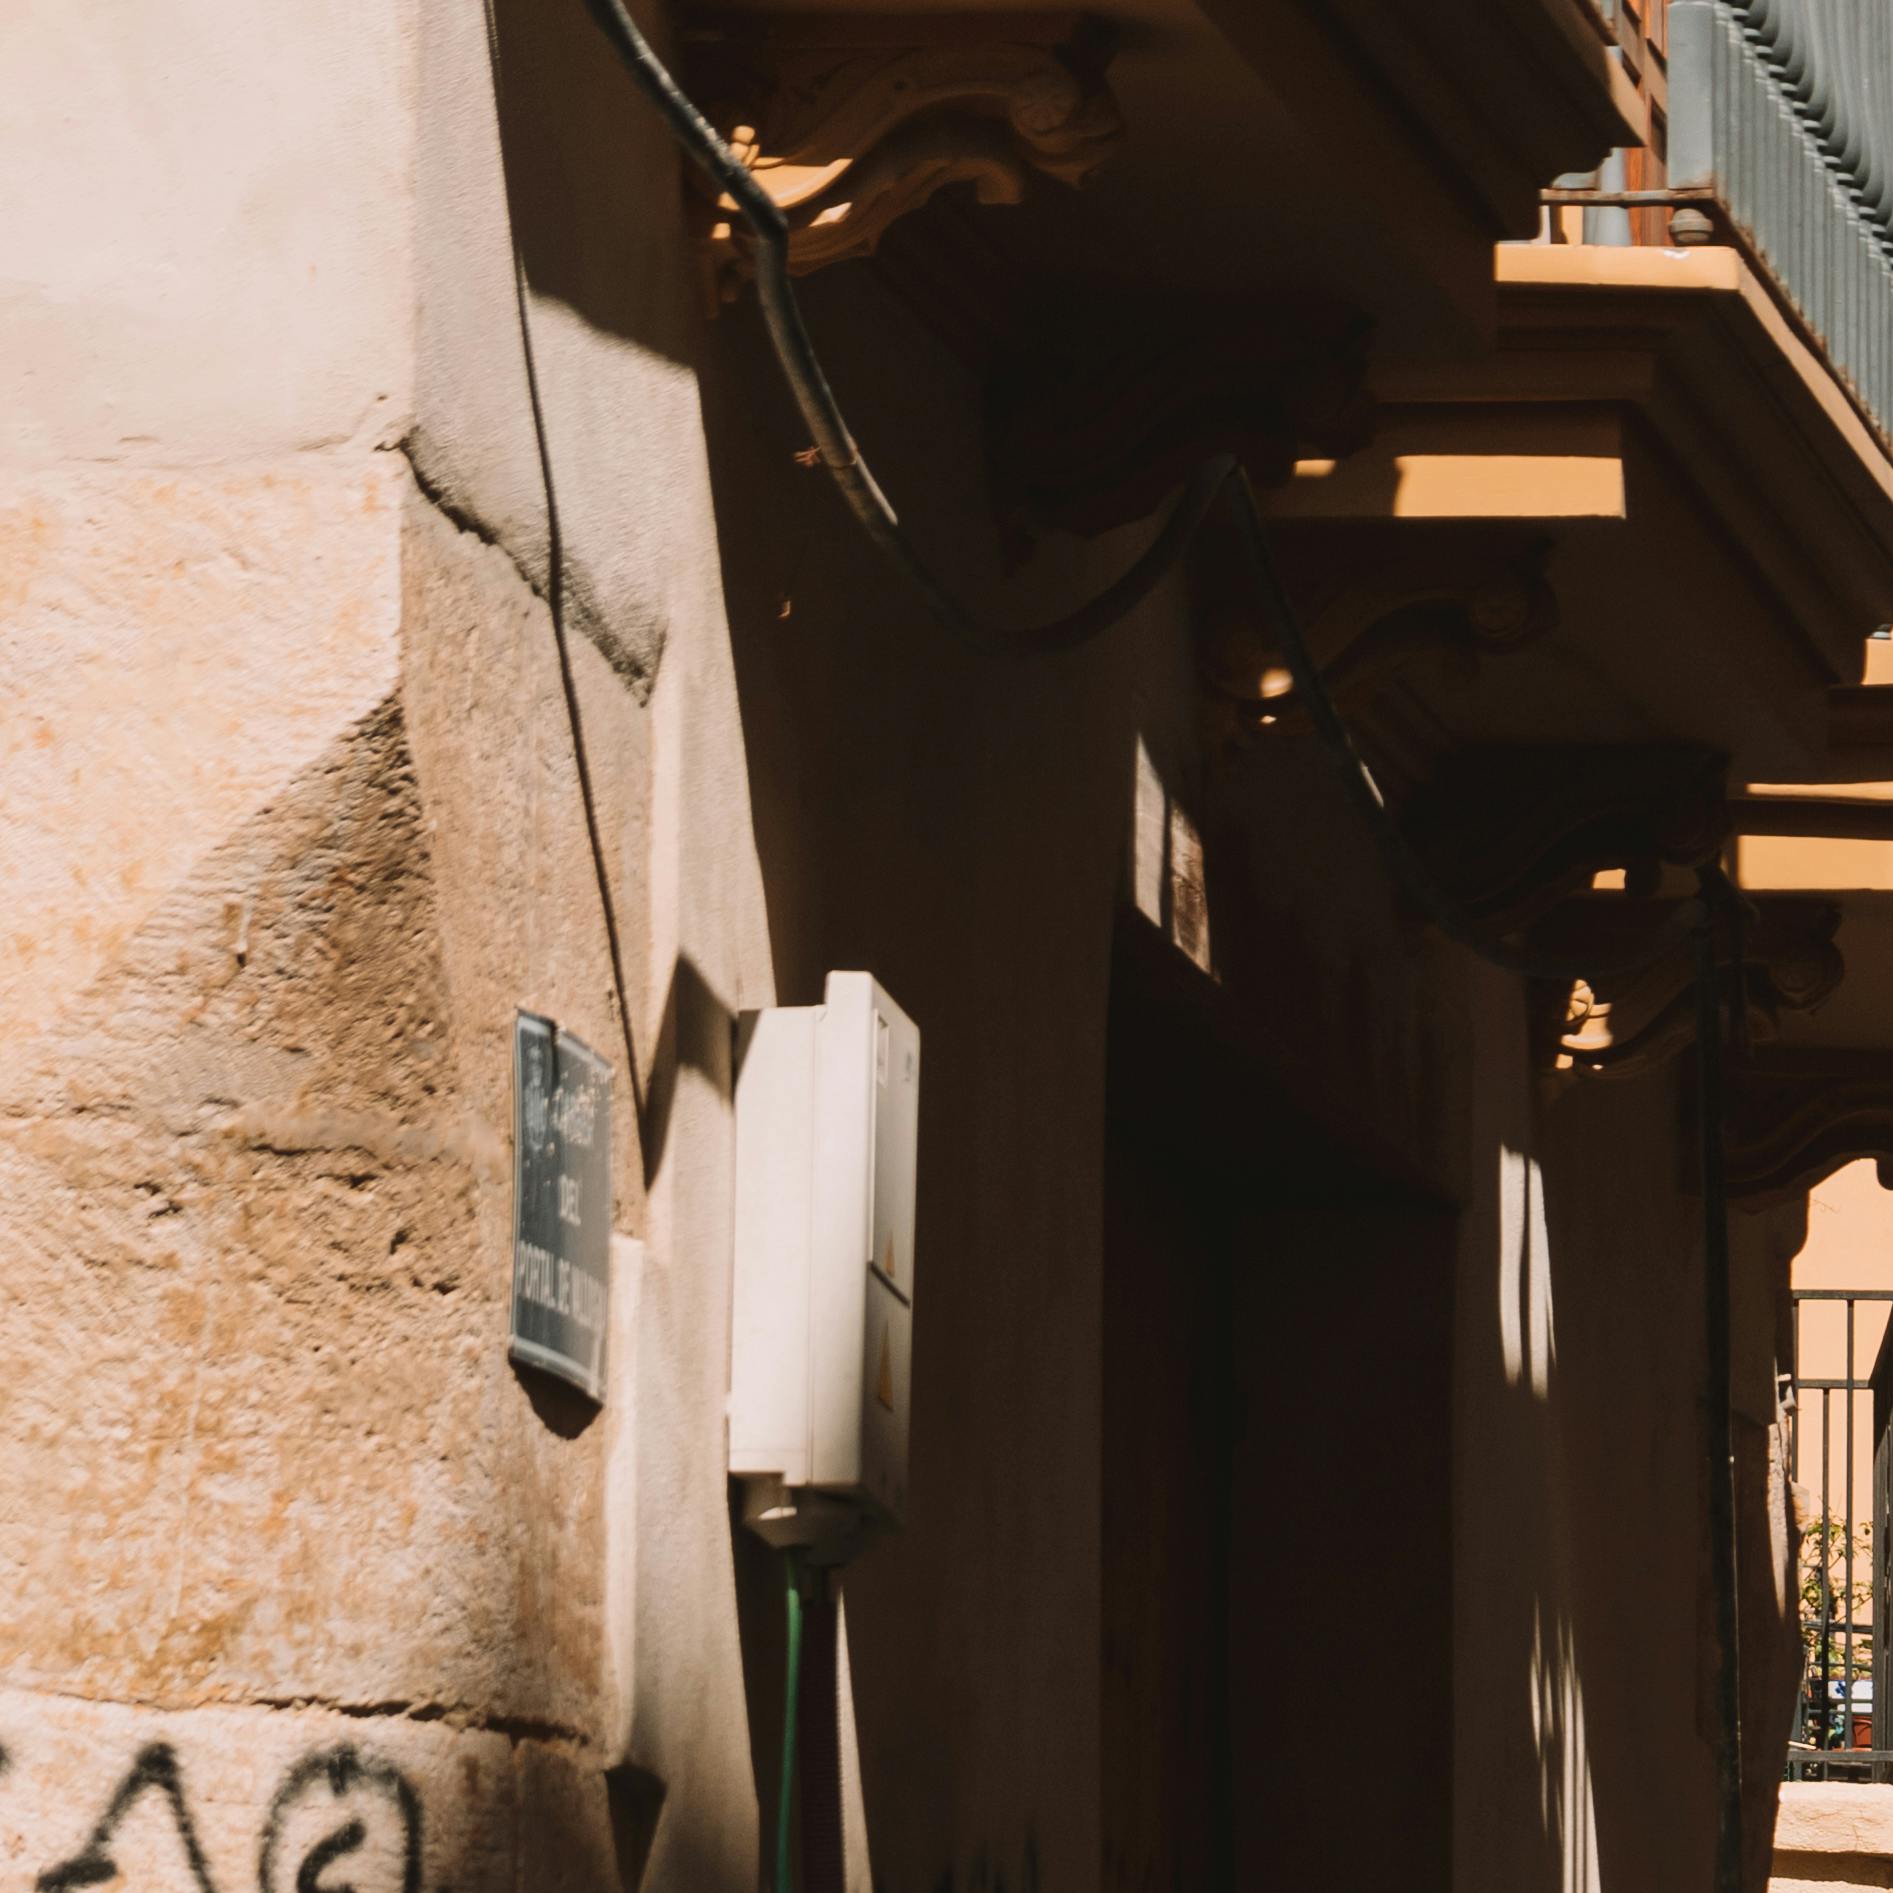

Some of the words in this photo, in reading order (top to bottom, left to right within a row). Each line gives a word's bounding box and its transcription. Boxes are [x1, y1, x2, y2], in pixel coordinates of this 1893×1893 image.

[559, 1173, 582, 1227] DEL
[516, 1240, 556, 1309] PORTAL
[558, 1257, 571, 1315] DE
